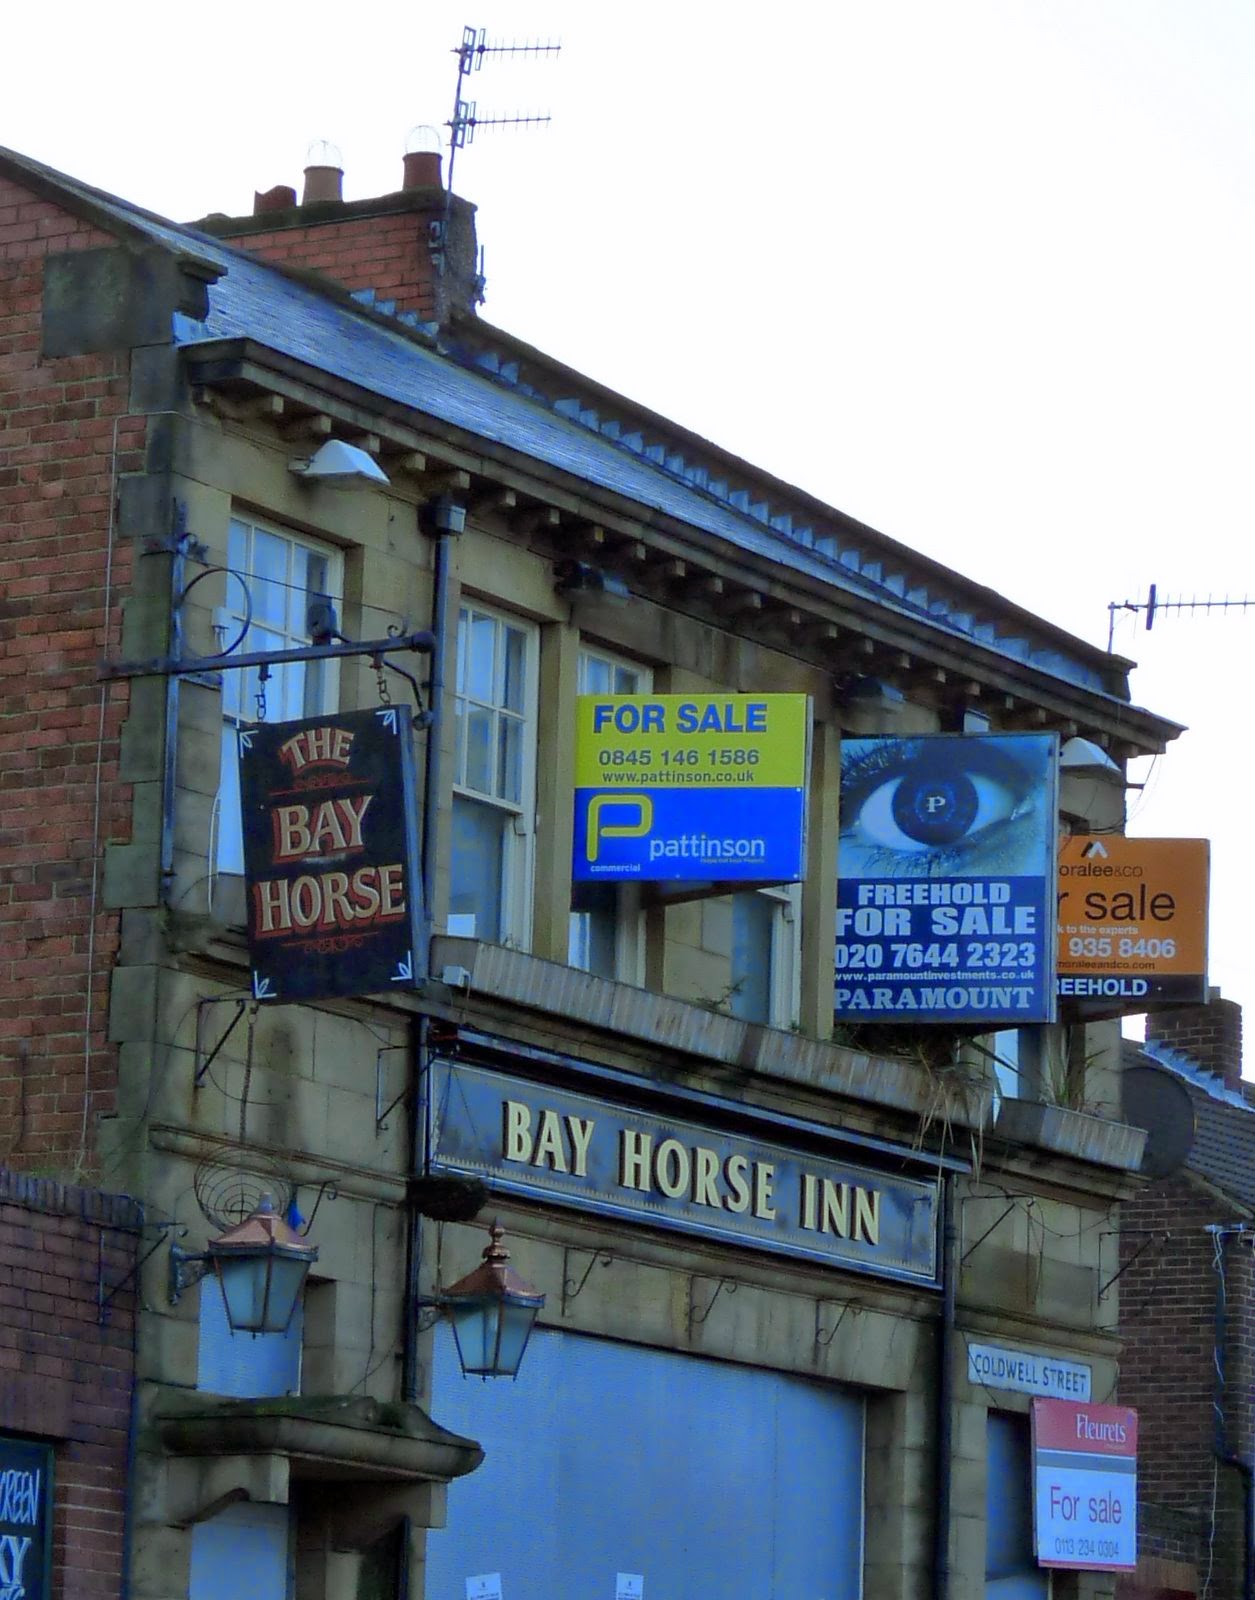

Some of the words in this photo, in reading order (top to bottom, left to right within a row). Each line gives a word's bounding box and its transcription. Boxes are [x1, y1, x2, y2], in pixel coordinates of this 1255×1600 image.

[594, 704, 665, 733] FOR
[676, 703, 768, 733] SALE
[279, 727, 354, 769] THE
[599, 750, 651, 766] 0845
[661, 750, 699, 766] 146
[708, 750, 759, 766] 1586
[602, 770, 754, 783] www.pattinson.co.uk
[273, 795, 373, 861] BAY
[650, 835, 765, 861] pattinson
[590, 864, 640, 872] commercial
[1059, 862, 1143, 877] oralee&co
[257, 864, 405, 934] HORSE
[858, 883, 1011, 905] FREEHOLD
[1085, 883, 1176, 921] sale
[835, 908, 911, 936] FOR
[931, 907, 1036, 935] SALE
[1066, 925, 1077, 934] to
[1079, 924, 1097, 934] the
[1099, 926, 1139, 935] experts
[835, 944, 883, 968] 020
[890, 943, 959, 968] 7644
[966, 942, 1035, 967] 2323
[1069, 937, 1112, 957] 935
[1119, 938, 1176, 959] 8406
[835, 987, 1035, 1009] PARAMOUNT
[1056, 978, 1147, 996] EEHOLD
[502, 1099, 594, 1177] BAY
[619, 1129, 776, 1221] HORSE
[802, 1173, 880, 1246] INN
[975, 1354, 1039, 1385] COLDWELL
[1043, 1367, 1087, 1393] STREET
[1076, 1413, 1127, 1443] Fleurets
[1050, 1486, 1080, 1521] For
[1088, 1490, 1122, 1524] sale
[1078, 1539, 1095, 1556] 234
